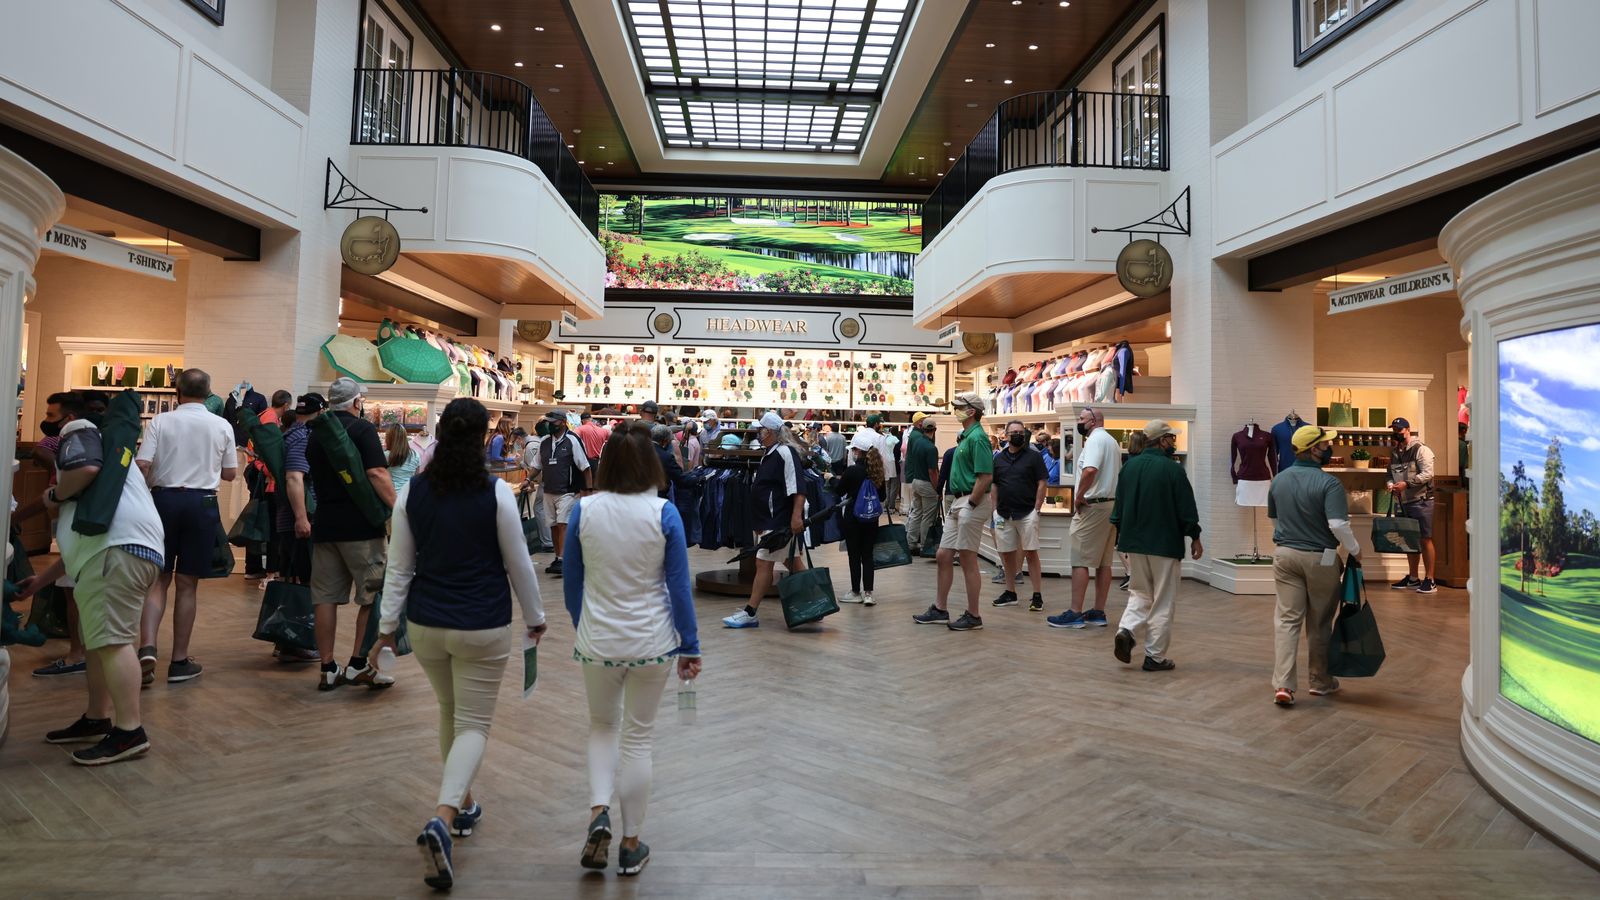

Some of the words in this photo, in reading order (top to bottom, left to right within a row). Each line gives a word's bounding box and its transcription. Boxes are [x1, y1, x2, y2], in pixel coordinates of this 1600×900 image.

[54, 231, 87, 250] MEN'S
[128, 251, 167, 272] T-SHIRTS
[1338, 288, 1385, 307] ACTIVEWEAR
[707, 318, 808, 333] HEADWEAR
